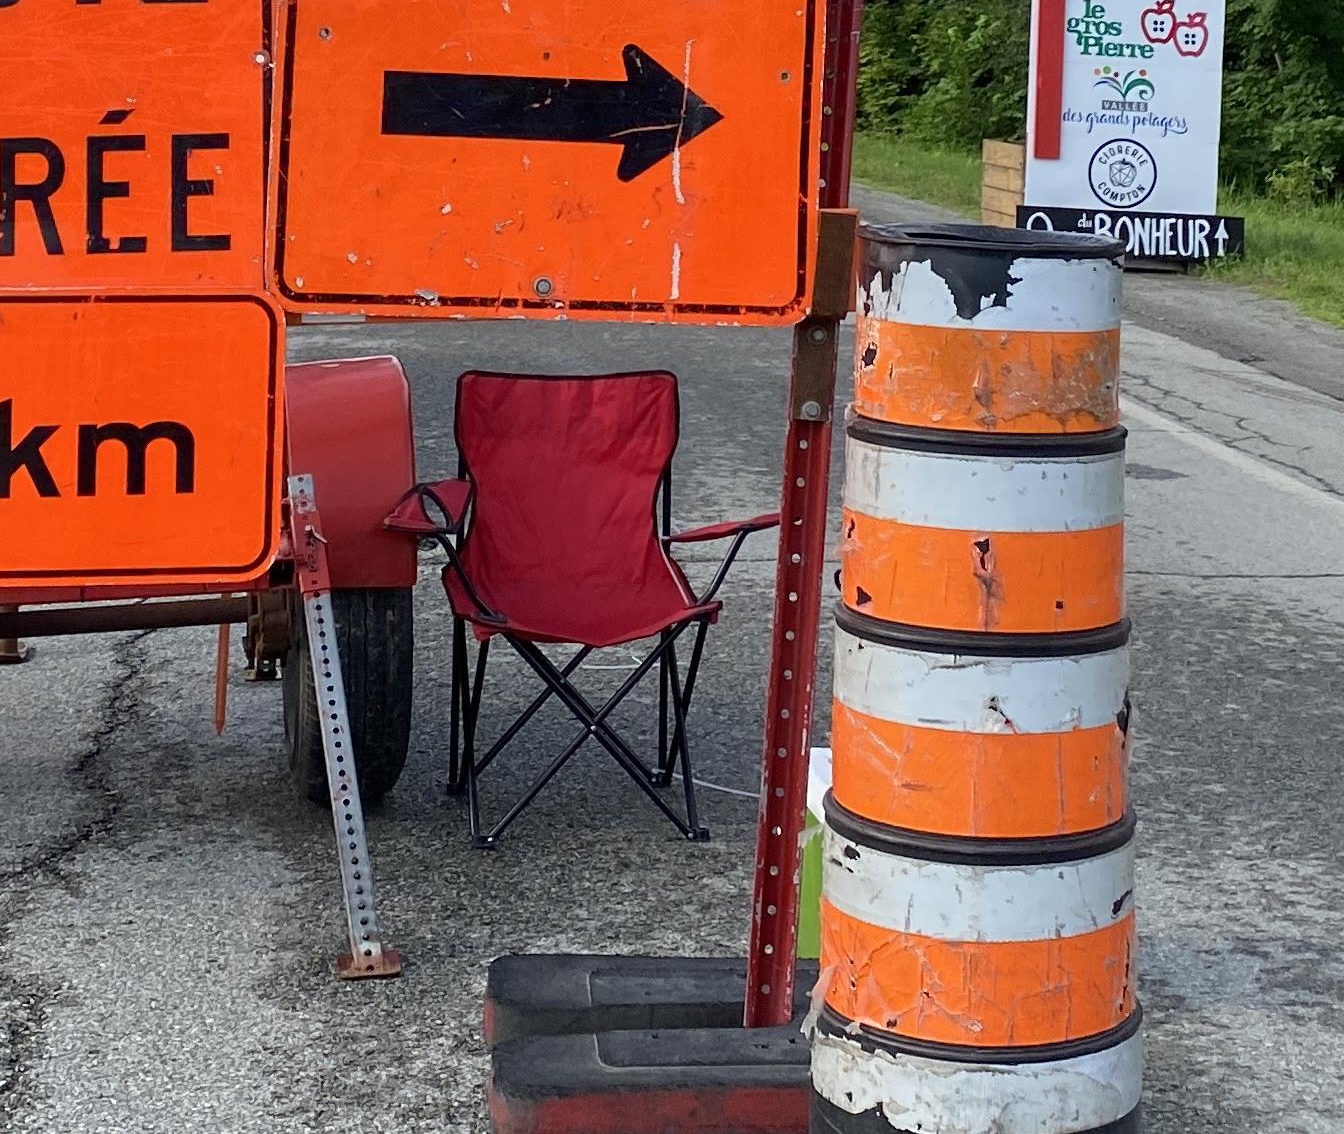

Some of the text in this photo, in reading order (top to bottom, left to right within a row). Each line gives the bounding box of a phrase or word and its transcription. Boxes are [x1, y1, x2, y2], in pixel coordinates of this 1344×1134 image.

[1083, 0, 1105, 19] le
[1066, 17, 1123, 45] gros
[1080, 35, 1154, 59] Pierre
[1062, 108, 1188, 137] des grands potagers
[1098, 181, 1146, 202] COMPTON
[1077, 212, 1093, 228] du
